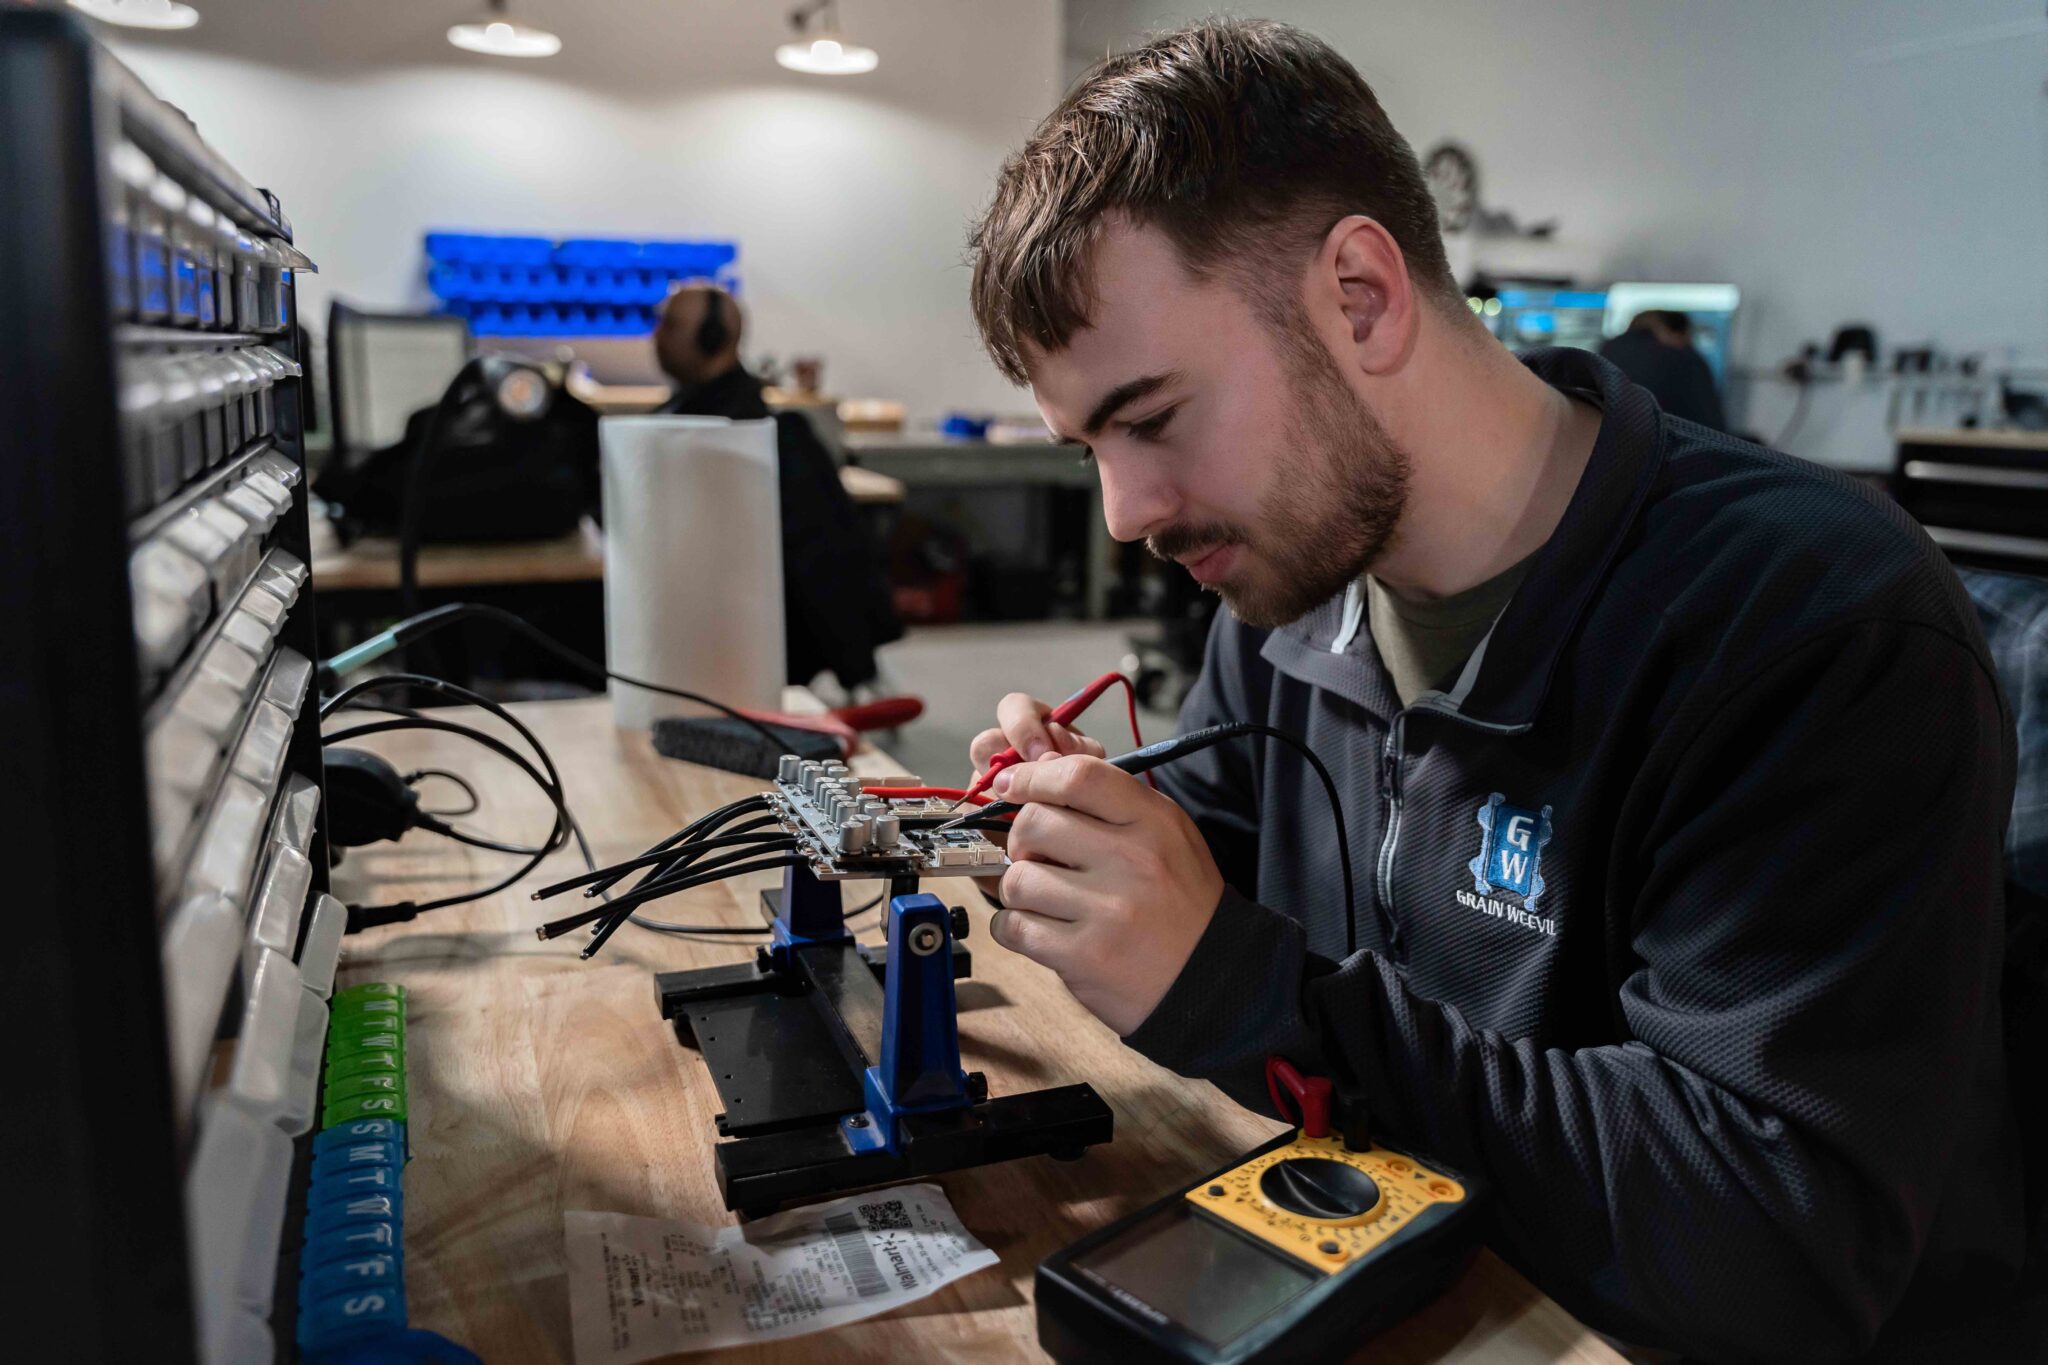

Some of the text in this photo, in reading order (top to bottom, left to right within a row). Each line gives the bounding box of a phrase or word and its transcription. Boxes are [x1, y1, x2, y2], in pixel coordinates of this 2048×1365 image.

[1507, 815, 1534, 851] G
[1501, 850, 1528, 884] W
[1456, 890, 1556, 936] GRAIN WEEVIL
[361, 1099, 393, 1110] S
[351, 1123, 384, 1134] S
[350, 1145, 384, 1162] M
[348, 1170, 384, 1184] T
[345, 1227, 385, 1243] T
[344, 1260, 385, 1275] F
[344, 1295, 385, 1316] S
